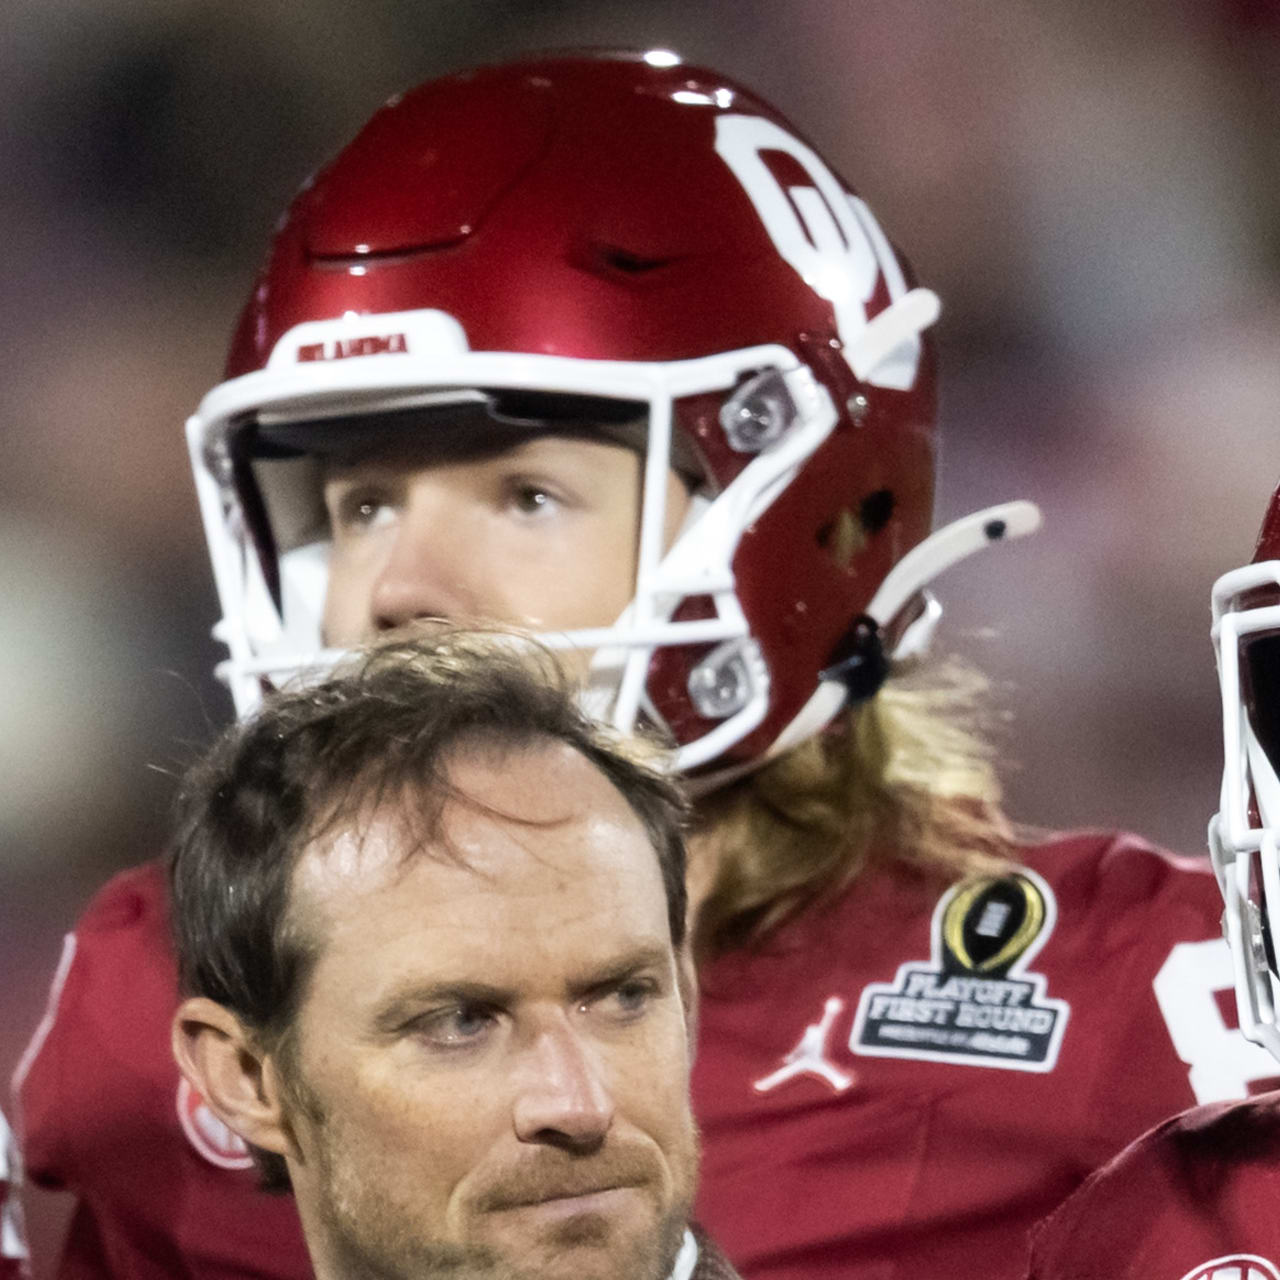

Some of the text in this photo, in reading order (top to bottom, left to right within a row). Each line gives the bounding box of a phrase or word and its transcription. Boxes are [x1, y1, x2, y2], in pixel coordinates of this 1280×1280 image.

[905, 974, 1031, 1006] PLAYOFF
[869, 996, 1054, 1035] FIRST ROUND
